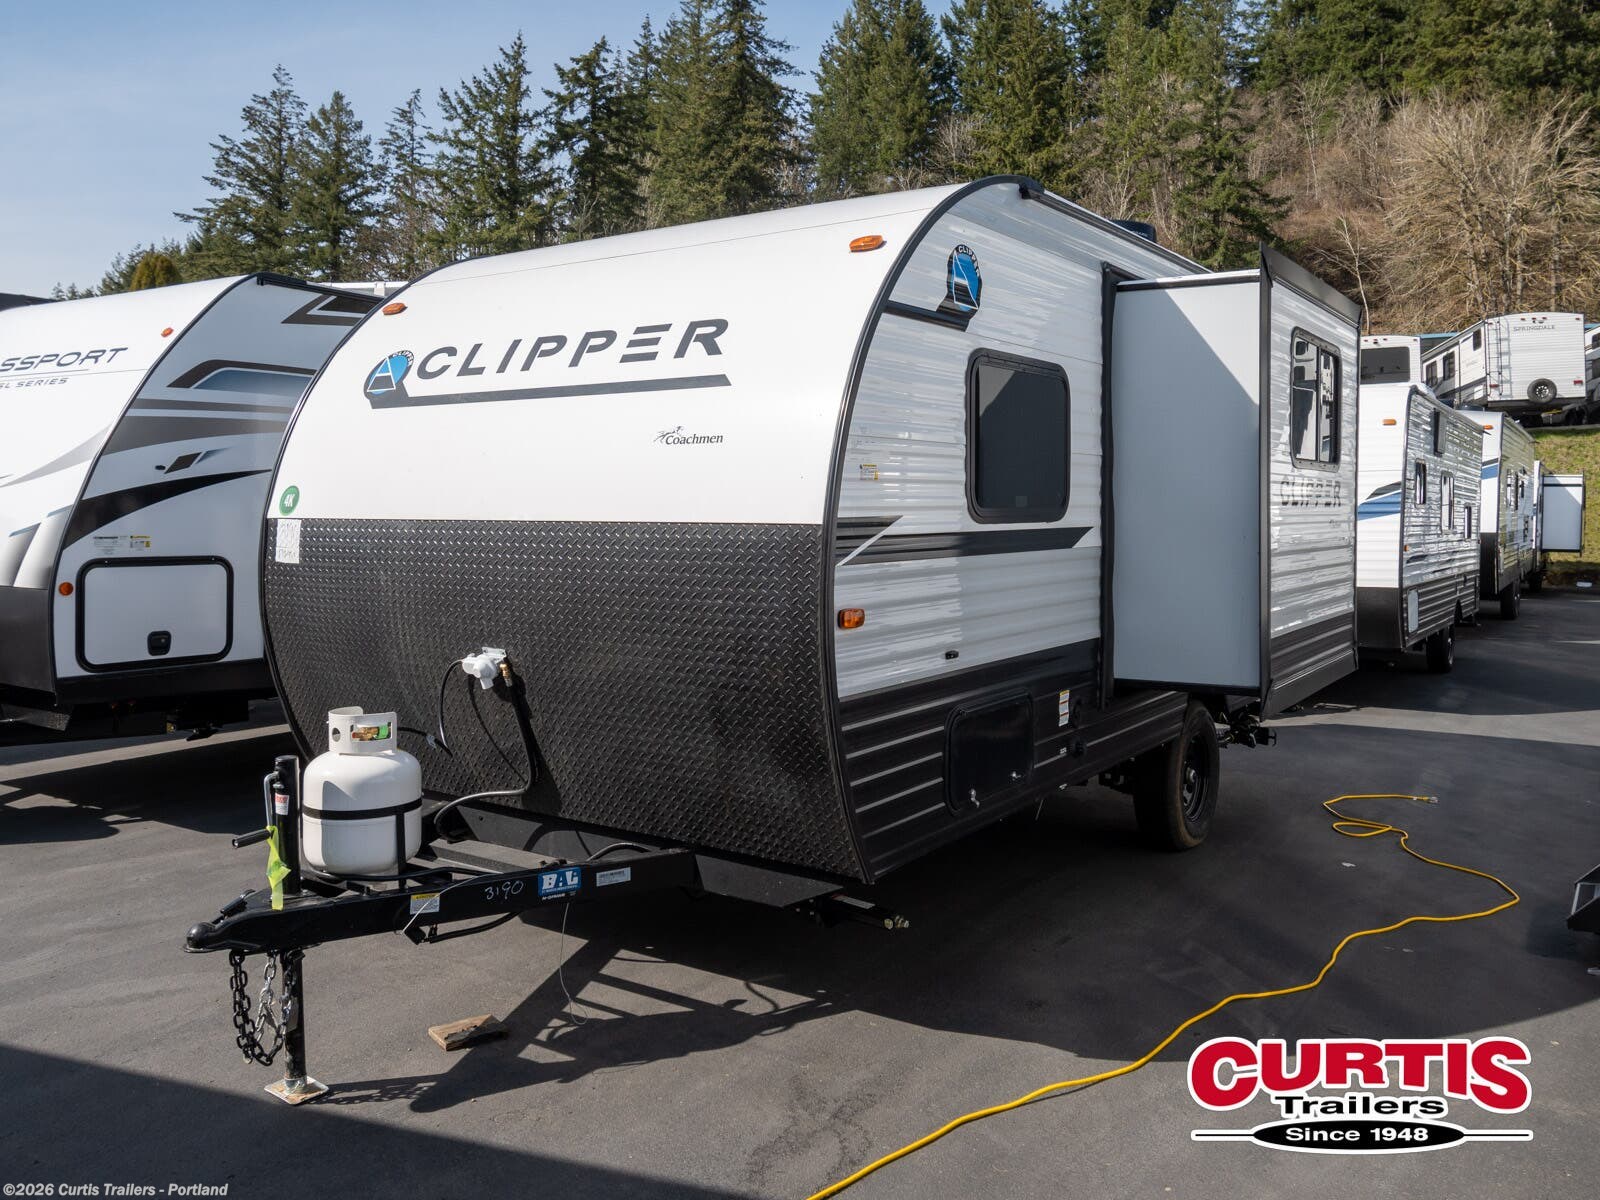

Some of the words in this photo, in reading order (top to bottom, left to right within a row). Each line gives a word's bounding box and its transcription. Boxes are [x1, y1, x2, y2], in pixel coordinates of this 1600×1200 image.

[416, 318, 729, 381] CLIPPER
[16, 377, 68, 388] SERIES
[665, 433, 723, 445] Coachmen
[1280, 478, 1341, 507] CLIPPER
[484, 880, 524, 900] 3190
